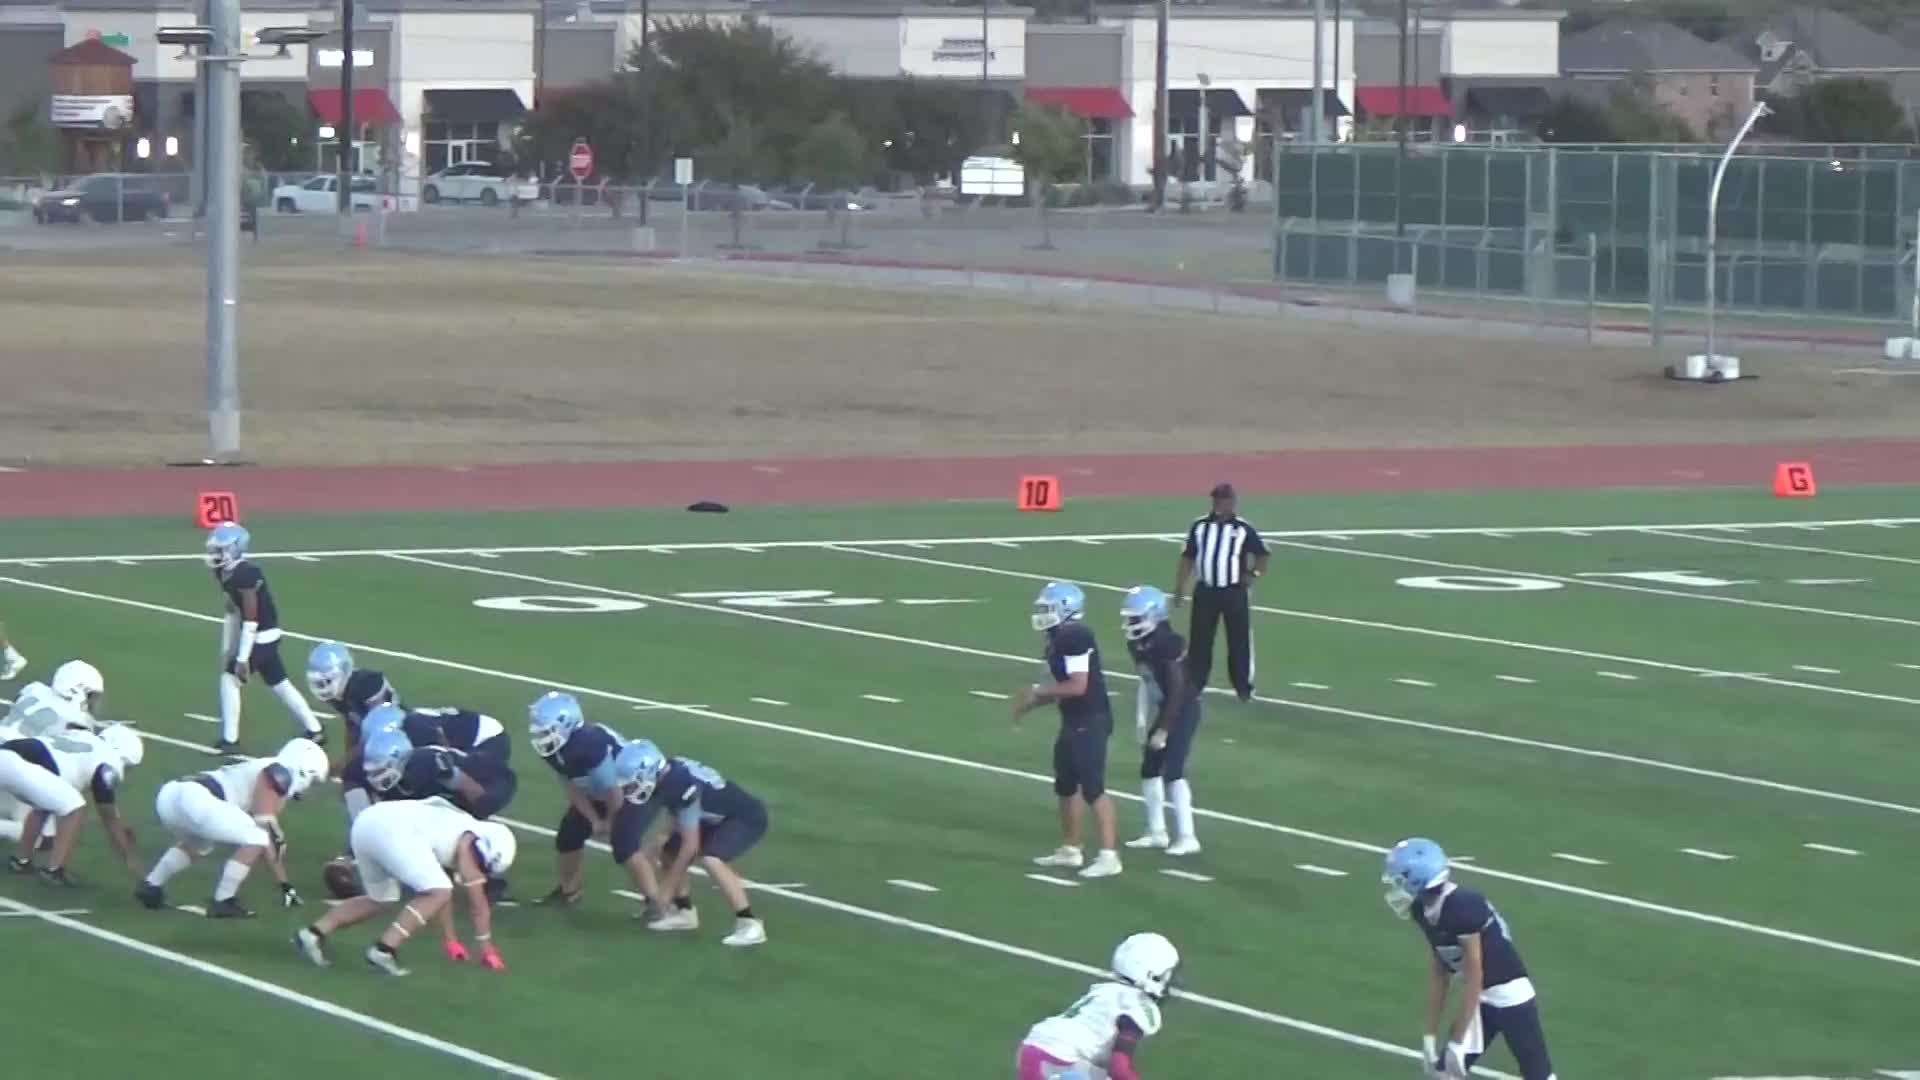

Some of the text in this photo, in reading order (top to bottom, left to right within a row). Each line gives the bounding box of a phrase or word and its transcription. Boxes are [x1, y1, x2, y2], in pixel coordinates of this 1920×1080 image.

[1788, 467, 1809, 491] G
[1025, 480, 1049, 507] 10
[203, 496, 234, 522] 20
